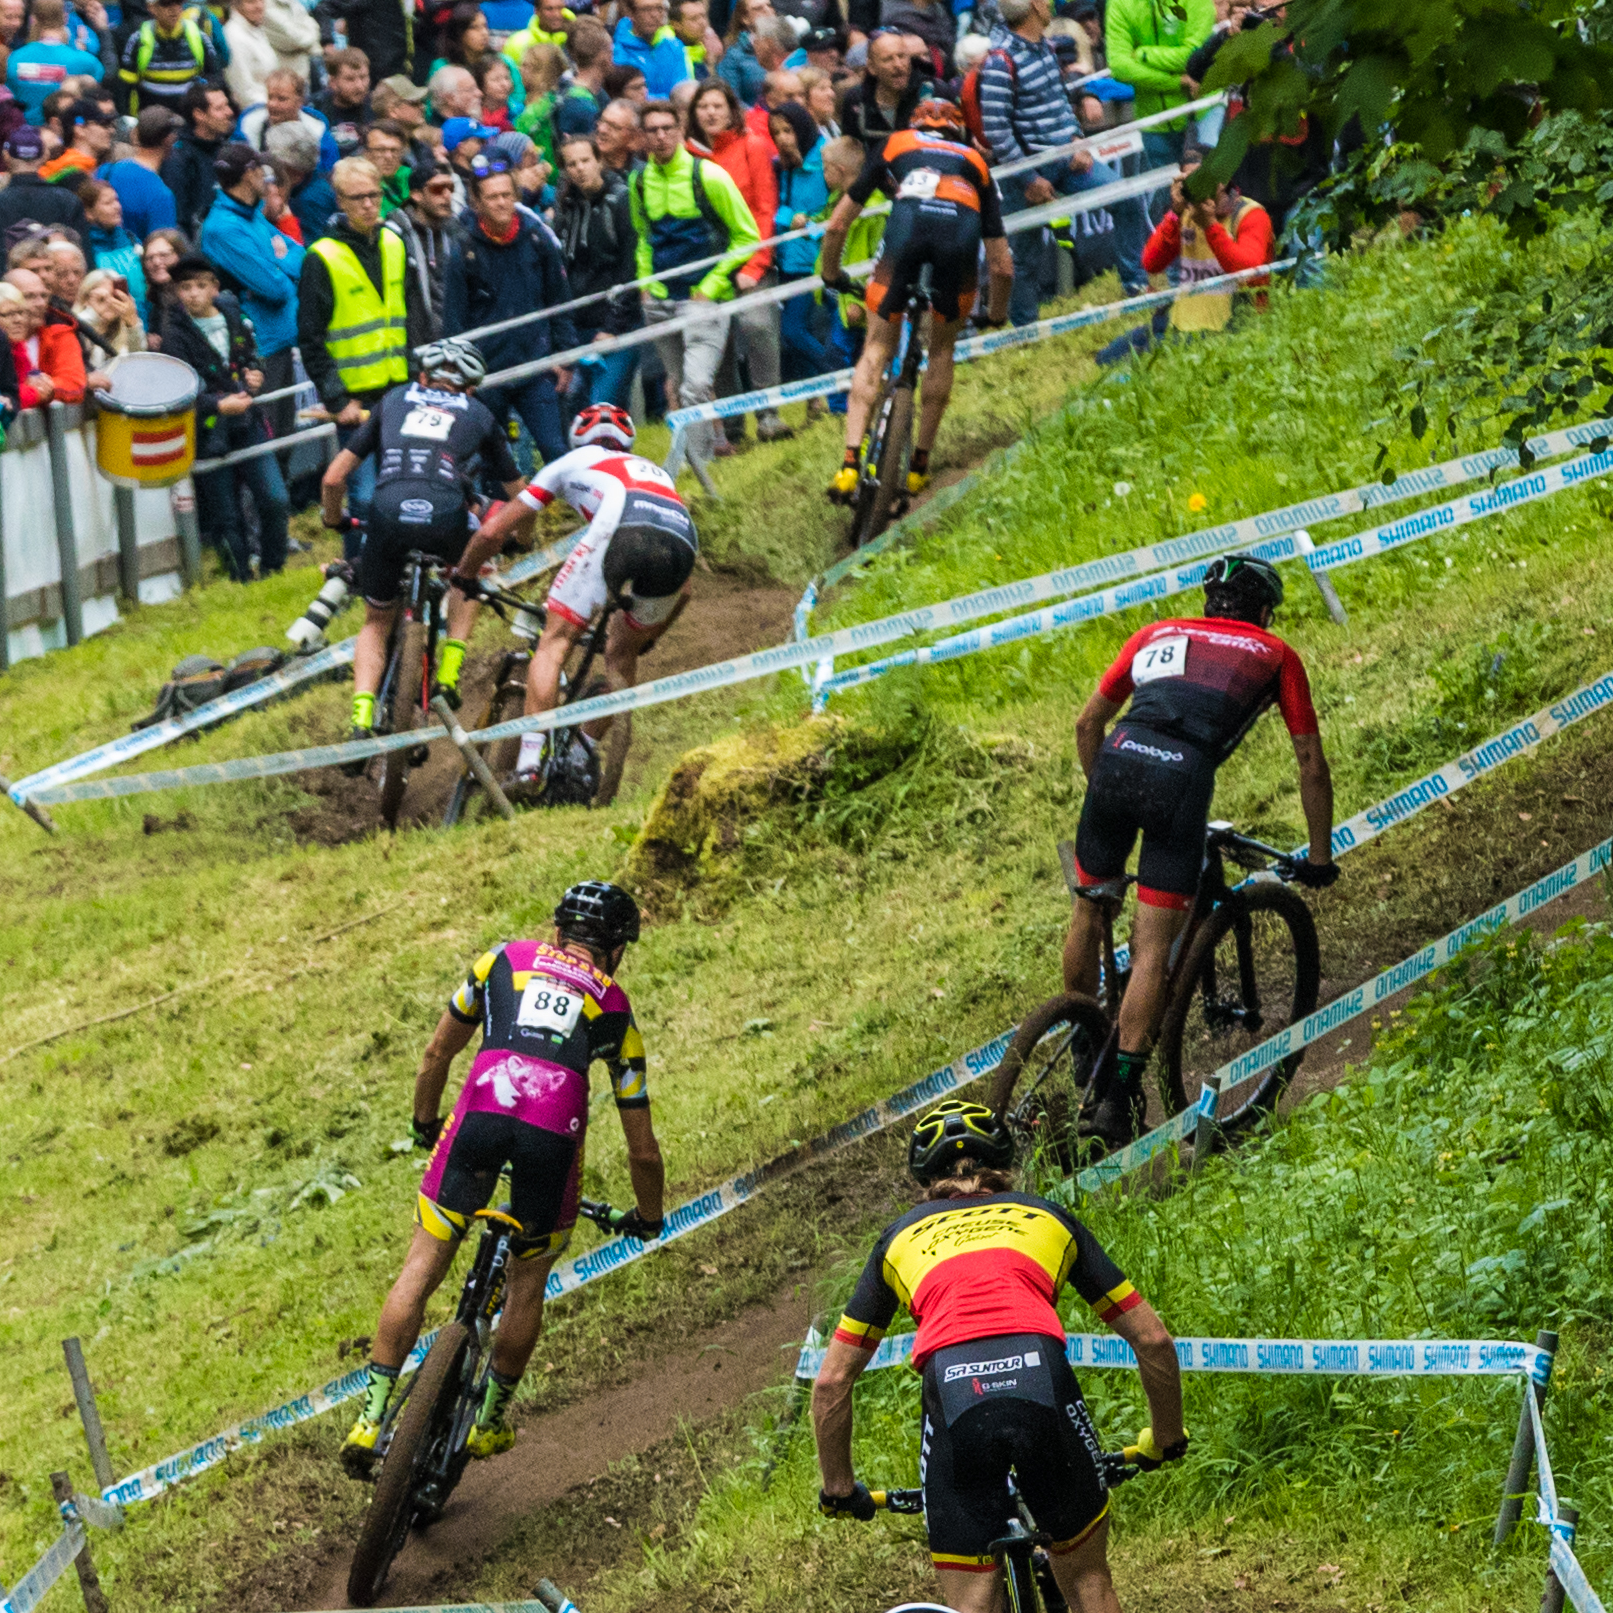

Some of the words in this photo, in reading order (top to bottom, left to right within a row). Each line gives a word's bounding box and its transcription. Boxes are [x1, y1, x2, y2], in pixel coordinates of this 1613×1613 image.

[1377, 506, 1454, 546] SHIMANO
[1469, 474, 1546, 515] SHIMANO
[1053, 595, 1105, 626] SHIMANO
[1115, 576, 1167, 608] SHIMANO
[1177, 563, 1208, 588] SHIM
[1144, 645, 1175, 669] 78
[1366, 773, 1449, 831] SHIMANO
[1458, 721, 1541, 781] SHIMANO
[534, 991, 571, 1017] 88
[909, 1206, 1047, 1243] SCOTT
[932, 1218, 1022, 1240] CREUSE
[572, 1234, 645, 1284] SHIMANO
[970, 1355, 1022, 1376] SUNTOUR
[1201, 1341, 1248, 1369] SHIMANO
[1257, 1341, 1304, 1369] SHIMANO
[1313, 1342, 1359, 1370] SHIMANO
[1368, 1343, 1415, 1370] SHIMANO
[1424, 1343, 1471, 1371] SHIMANO
